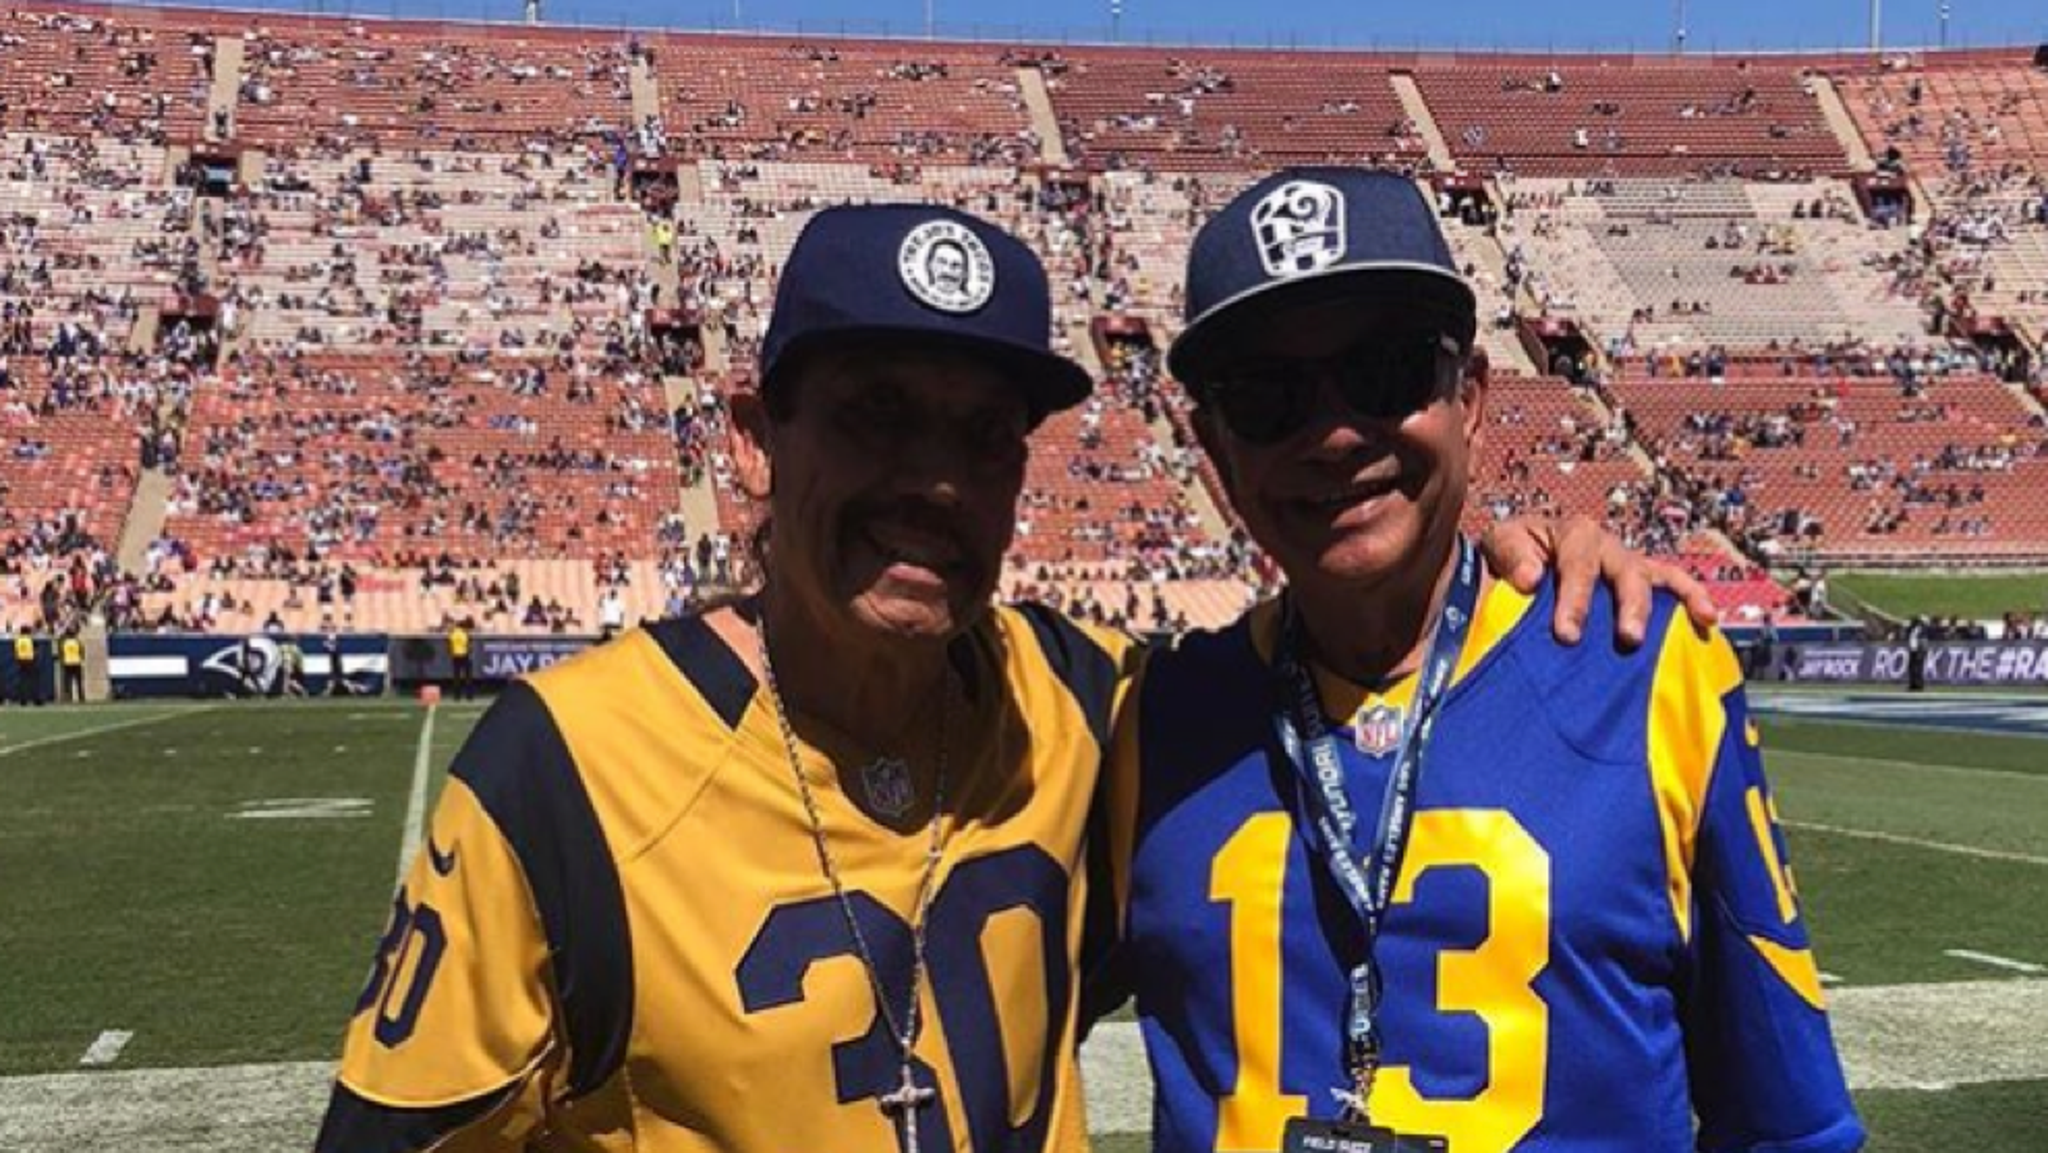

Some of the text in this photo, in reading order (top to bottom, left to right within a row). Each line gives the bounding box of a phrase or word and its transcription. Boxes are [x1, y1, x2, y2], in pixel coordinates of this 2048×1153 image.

[483, 653, 534, 674] JAY
[1872, 647, 1943, 679] ROK
[1947, 648, 1997, 679] THE
[734, 841, 1072, 1153] 30
[1209, 808, 1551, 1153] 13
